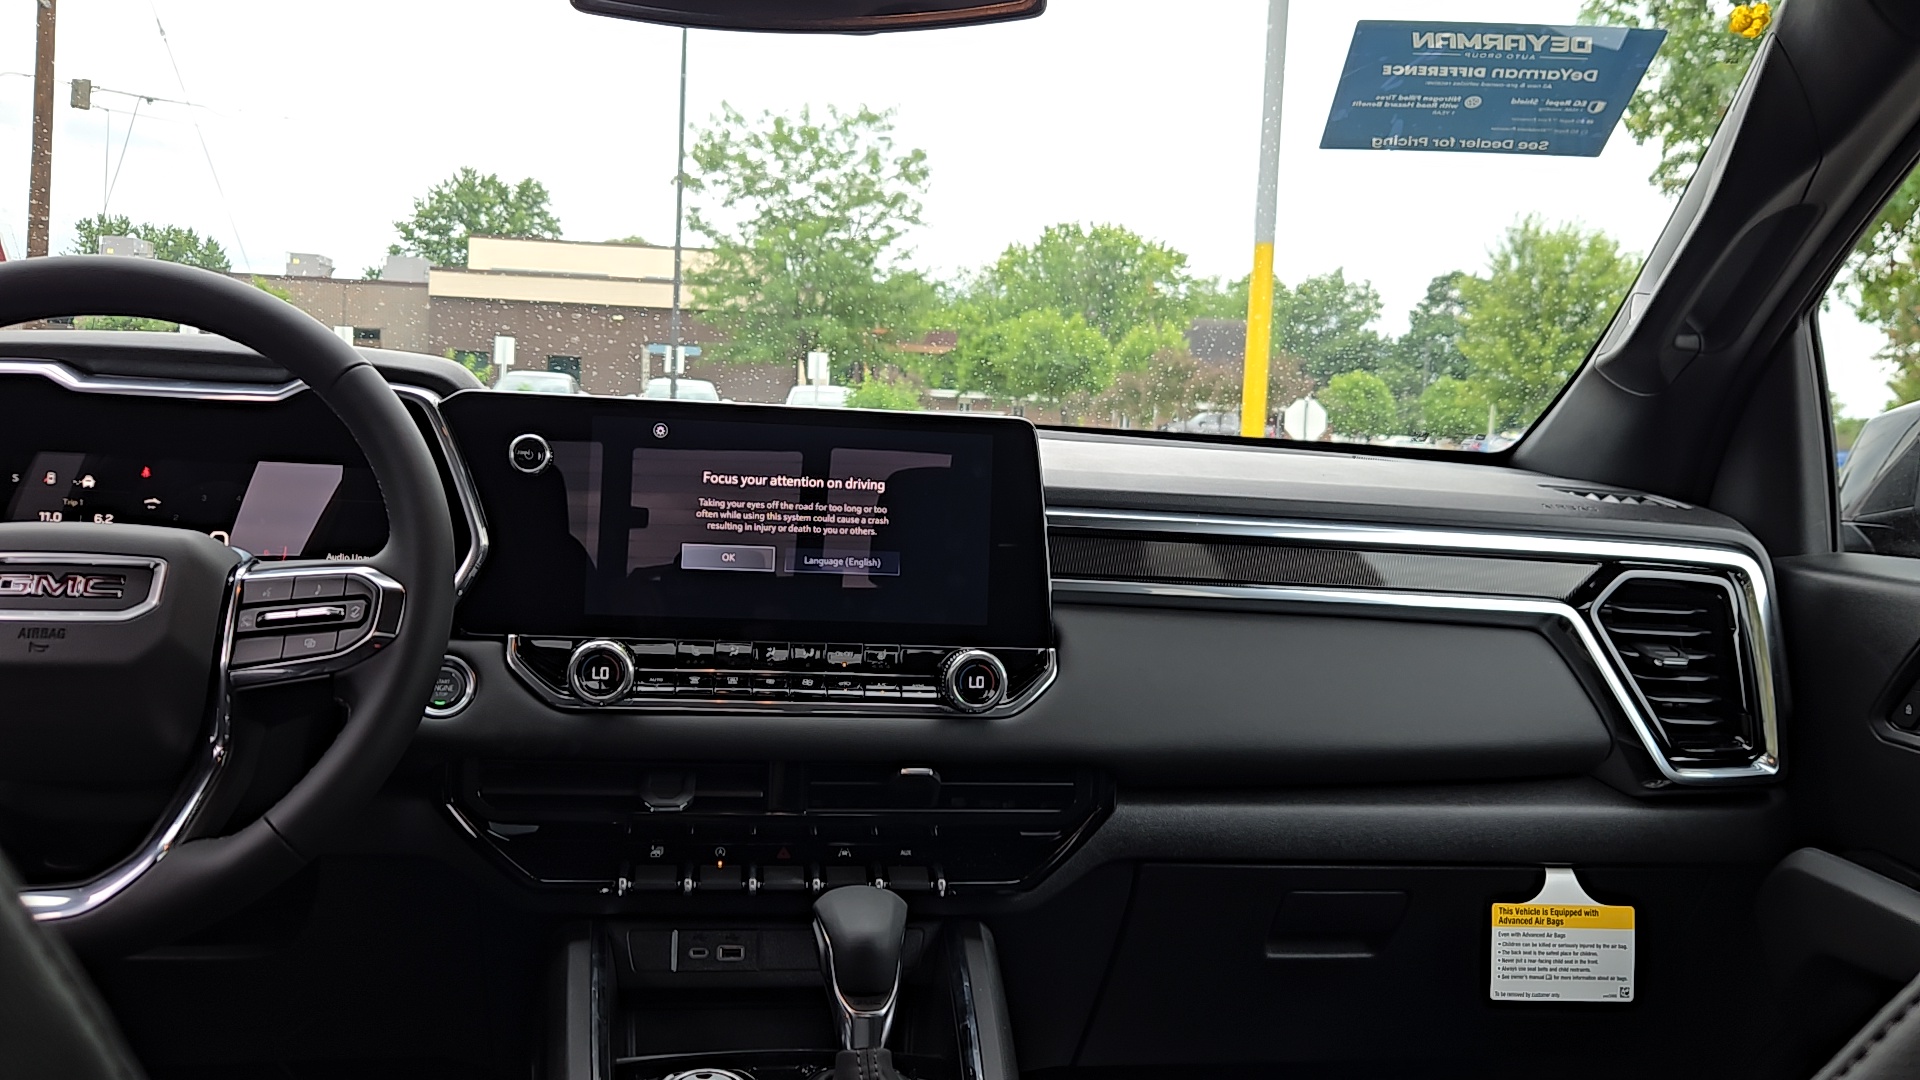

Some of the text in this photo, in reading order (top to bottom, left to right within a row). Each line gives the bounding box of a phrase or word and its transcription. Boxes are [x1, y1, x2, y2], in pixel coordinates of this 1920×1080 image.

[703, 471, 885, 494] Focus your attention on driving
[63, 498, 84, 507] Trip 1
[699, 498, 888, 514] Taking your eyes off the road for too long or too
[39, 512, 114, 524] 11.0 6.2
[696, 511, 719, 519] often
[720, 511, 742, 520] while
[743, 512, 765, 522] using
[766, 512, 782, 521] this
[783, 514, 812, 523] system
[813, 513, 836, 523] could
[837, 516, 860, 524] cause
[868, 516, 889, 525] crash
[707, 522, 743, 533] resulting
[744, 523, 753, 531] in
[754, 523, 777, 534] injury
[788, 524, 812, 533] death
[813, 525, 822, 533] to
[823, 527, 839, 536] you
[839, 527, 849, 535] or
[850, 526, 877, 536] others.
[326, 553, 350, 561] Audio
[722, 552, 736, 562] OK
[804, 556, 882, 569] Language (English)
[0, 574, 126, 598] GMC
[18, 627, 66, 639] AIRBAG
[592, 666, 610, 680] LO
[435, 684, 454, 692] NGINE
[968, 676, 985, 689] LO
[1499, 907, 1513, 915] This
[1515, 908, 1541, 916] Vehicle
[1550, 908, 1582, 918] Equipped
[1584, 909, 1599, 917] with
[1499, 917, 1533, 925] Advanced
[1547, 918, 1565, 927] Bags
